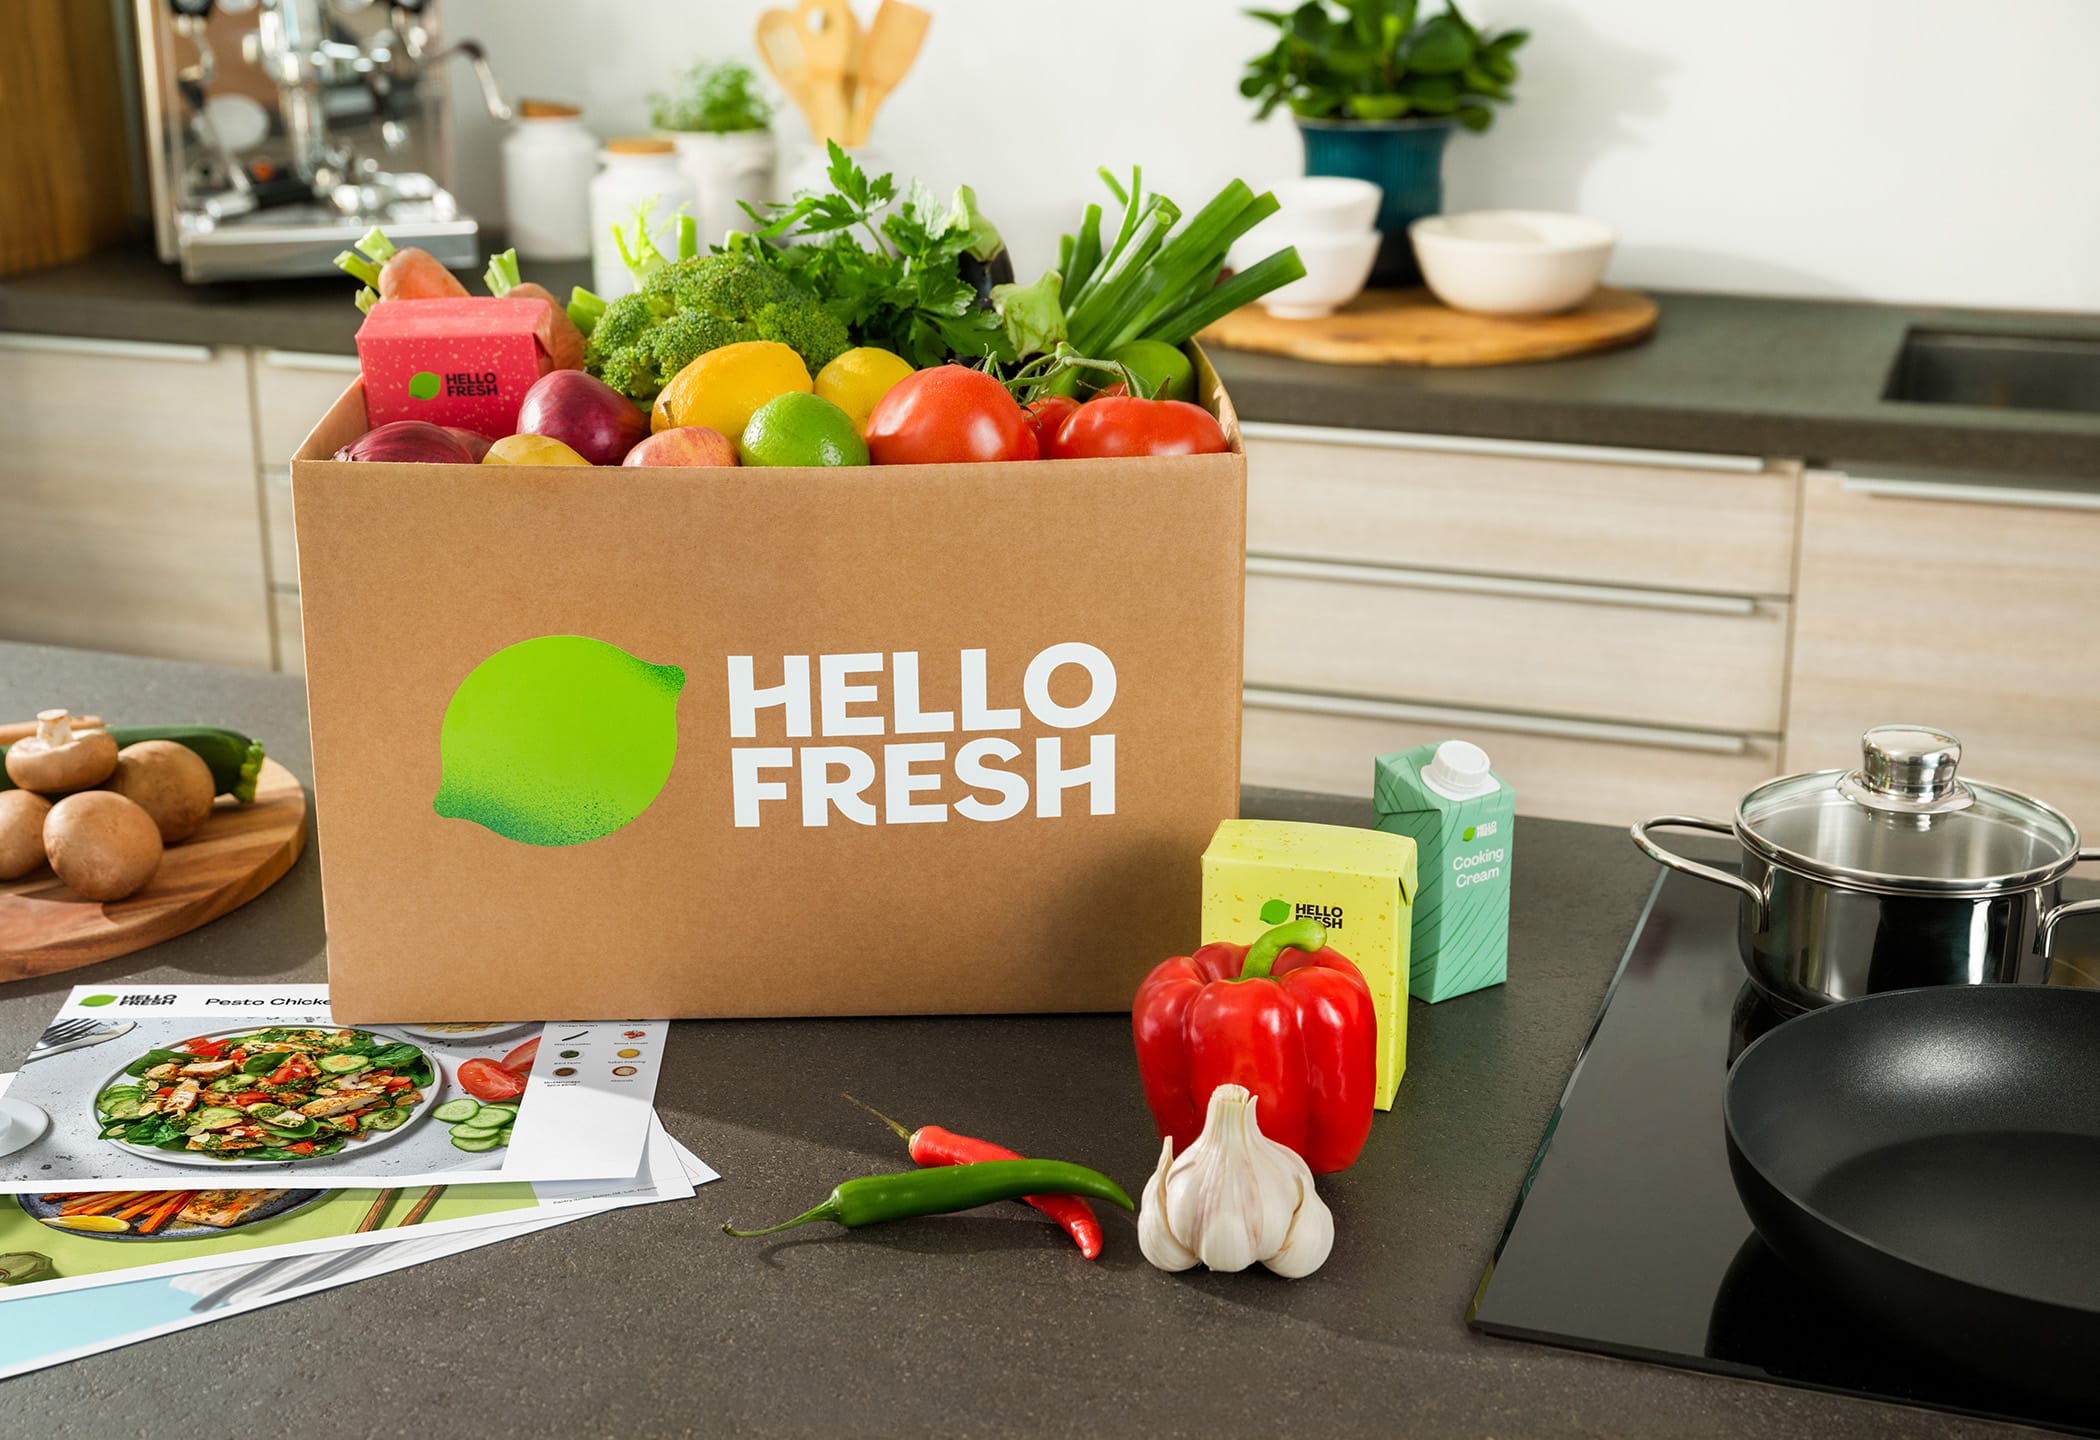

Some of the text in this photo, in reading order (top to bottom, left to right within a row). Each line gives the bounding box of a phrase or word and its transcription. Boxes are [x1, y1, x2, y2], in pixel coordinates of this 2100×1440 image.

[446, 372, 497, 385] HELLO
[447, 384, 498, 397] FRESH
[727, 642, 1117, 738] HELLO
[731, 734, 1116, 828] FRESH
[1452, 848, 1504, 871] Cooking
[1455, 867, 1499, 889] Cream
[1295, 903, 1343, 918] HELLO
[205, 998, 265, 1006] Pesto
